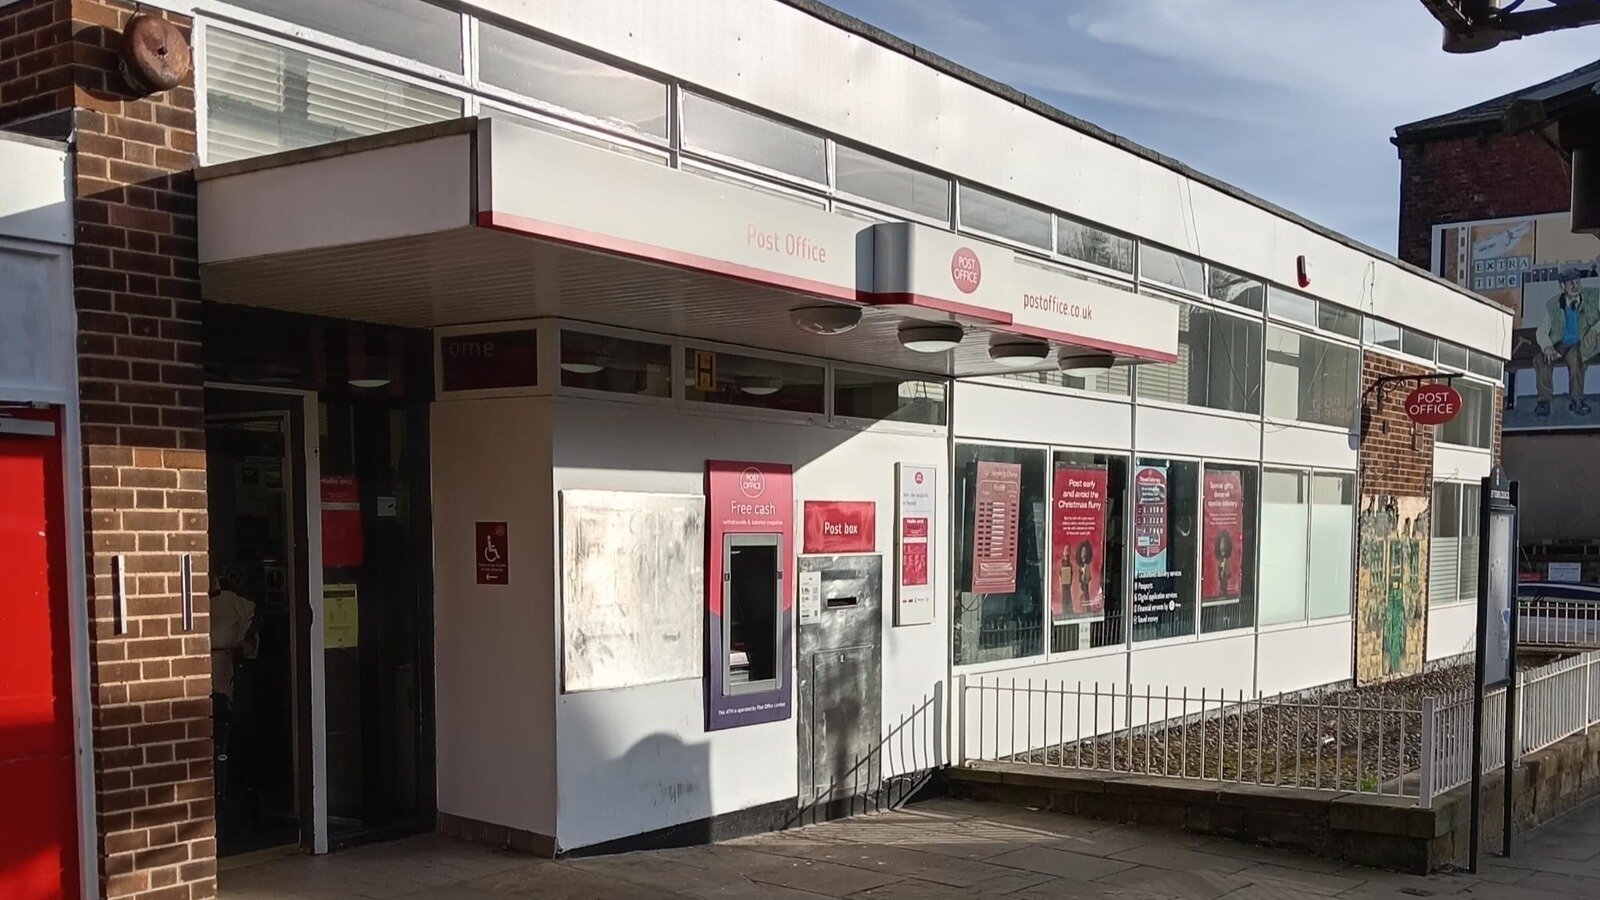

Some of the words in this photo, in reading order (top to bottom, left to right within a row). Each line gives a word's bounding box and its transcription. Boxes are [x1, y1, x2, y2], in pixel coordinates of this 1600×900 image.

[747, 223, 779, 252] Post
[785, 233, 826, 263] Office
[958, 256, 975, 270] POST
[1476, 259, 1527, 271] EXTRA
[954, 268, 978, 284] OFFICE
[1023, 294, 1093, 320] postoffice.co.uk
[1417, 392, 1449, 403] POST
[1409, 403, 1453, 415] OFFICE
[746, 474, 759, 482] POST
[1069, 479, 1082, 487] Post
[1083, 480, 1095, 489] early
[743, 482, 761, 490] OFFICE
[1063, 490, 1074, 498] and
[731, 501, 752, 515] Free
[754, 501, 776, 515] cash
[1058, 500, 1087, 509] Christmas
[1088, 501, 1101, 510] flurry
[824, 522, 842, 535] Post
[844, 522, 858, 535] box
